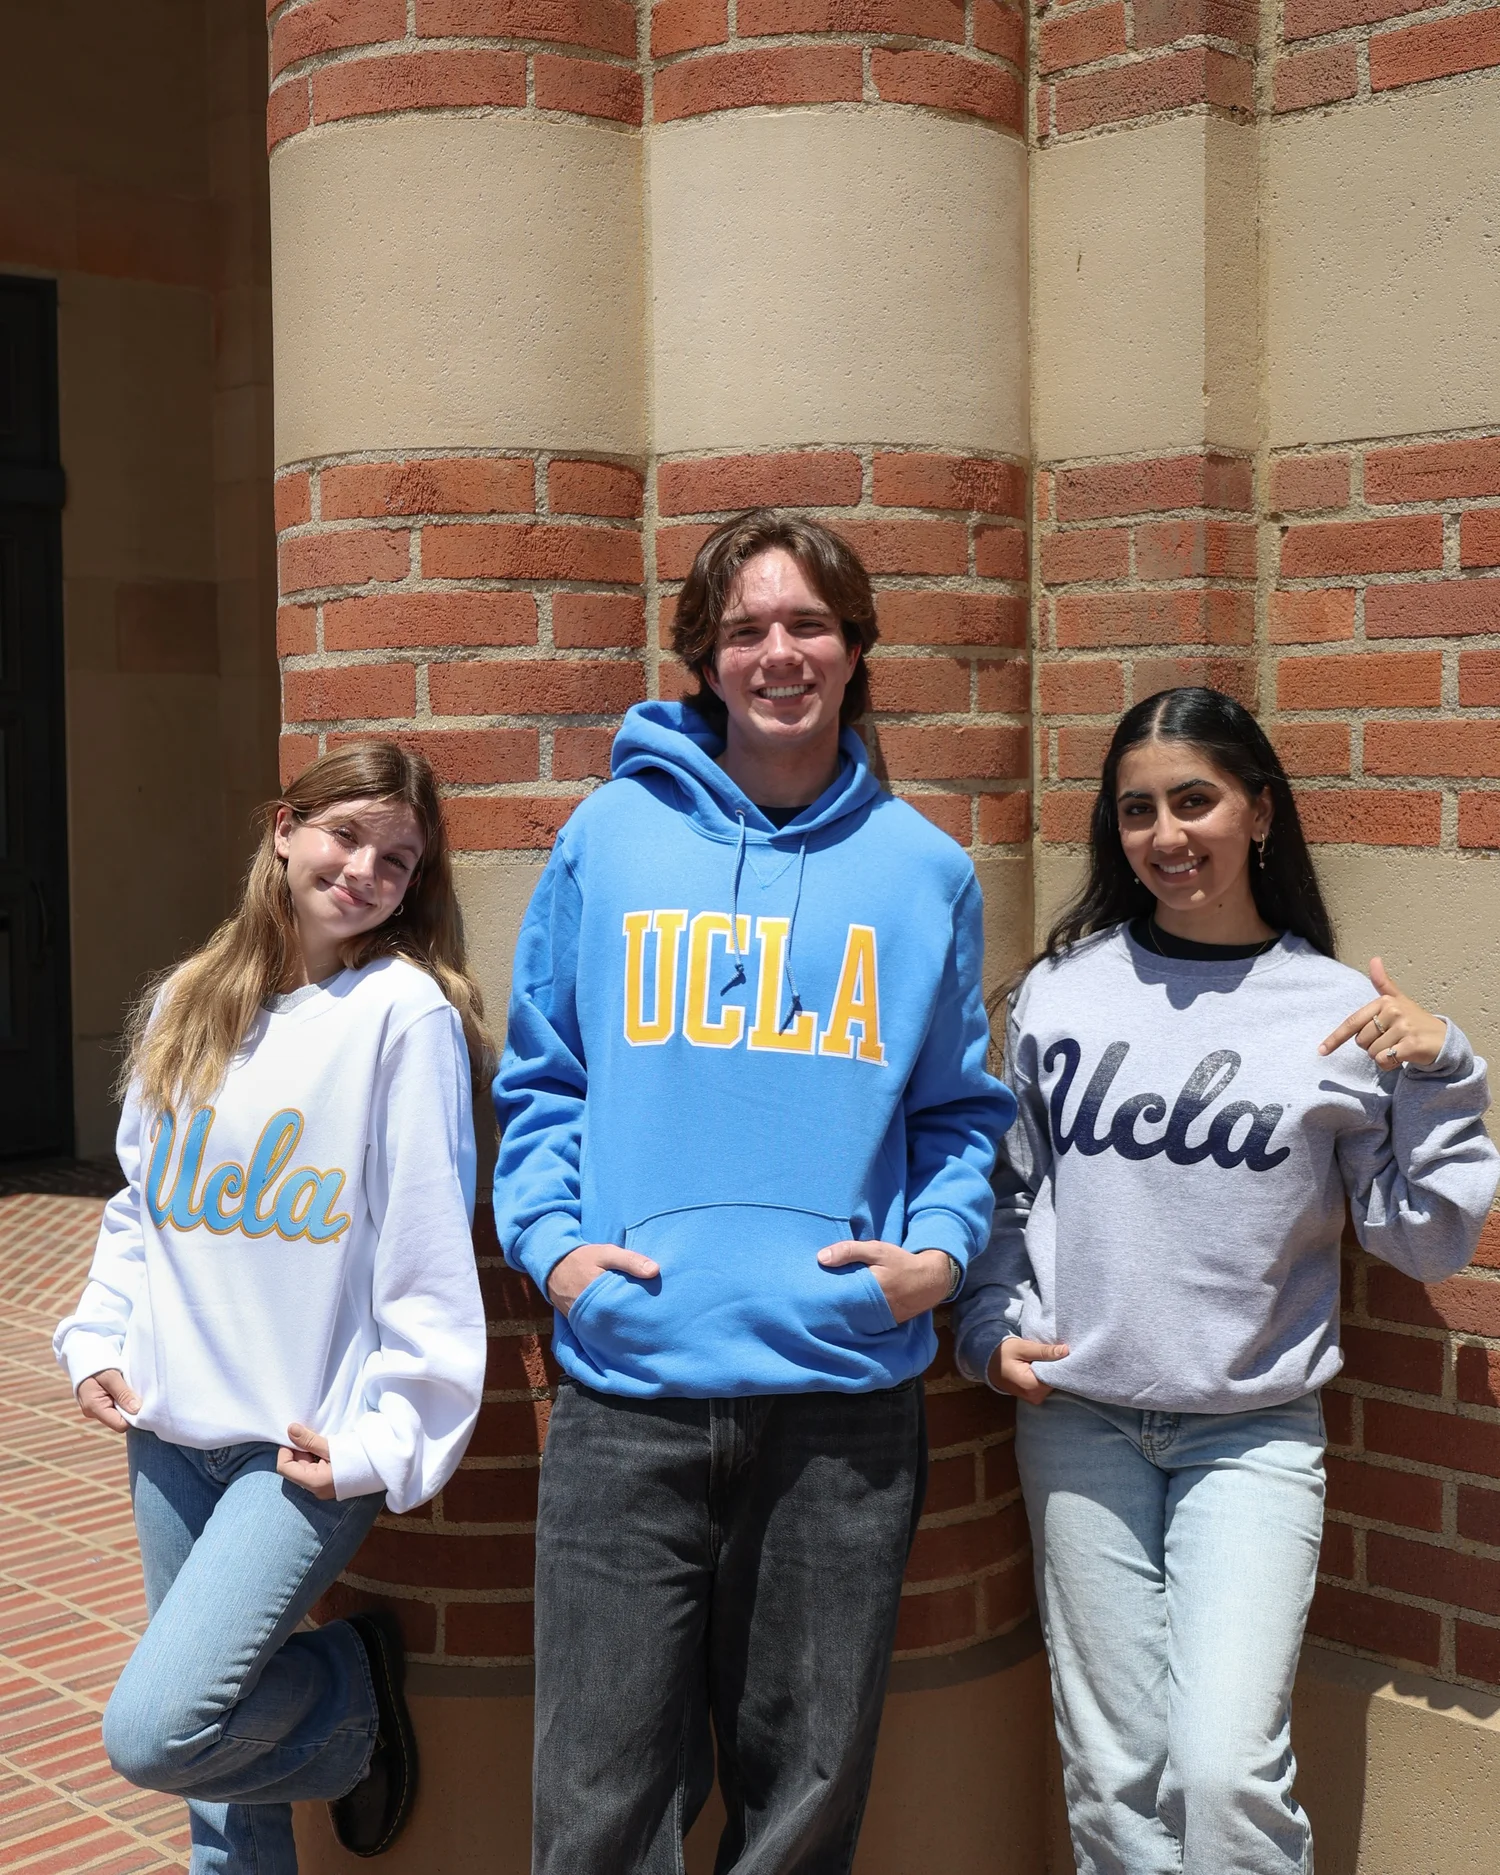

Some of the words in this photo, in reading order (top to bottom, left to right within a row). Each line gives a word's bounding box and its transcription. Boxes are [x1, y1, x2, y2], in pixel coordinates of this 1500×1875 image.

[622, 909, 886, 1066] UCLA
[146, 1104, 351, 1244] Ucla
[1043, 1038, 1291, 1172] Ucla
